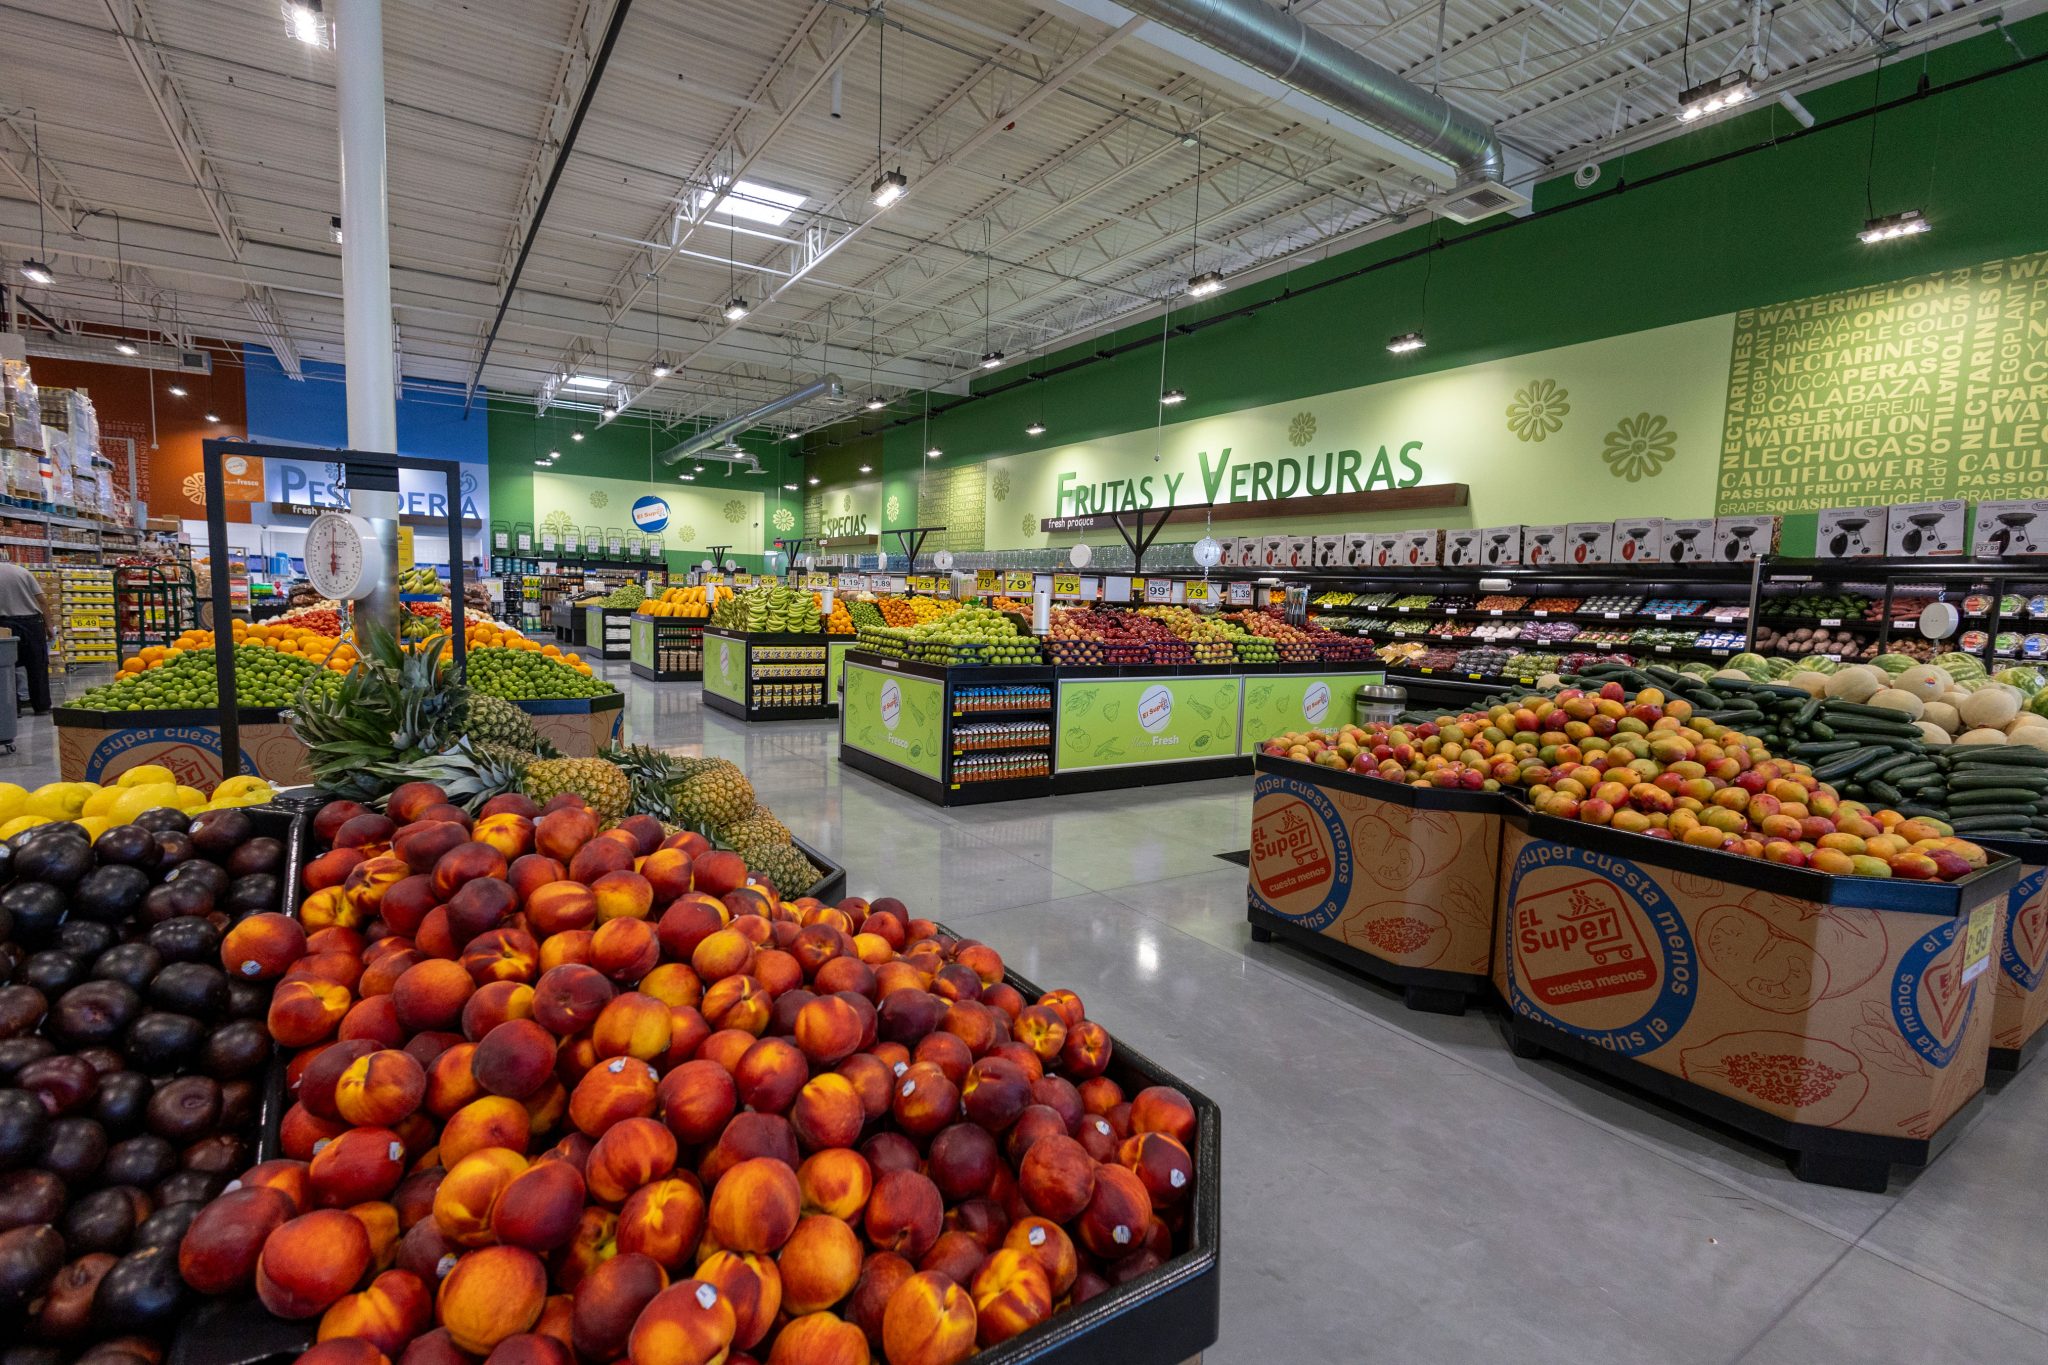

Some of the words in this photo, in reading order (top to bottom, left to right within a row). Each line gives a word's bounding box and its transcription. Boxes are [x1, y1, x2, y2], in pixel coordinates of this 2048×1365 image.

[1758, 278, 1945, 327] WATERMELON
[1775, 315, 1850, 342] PAPAYA
[1853, 294, 1971, 328] ONIONS
[1773, 325, 1892, 357] PINEAPPLE
[1898, 313, 1969, 336] GOLD
[1998, 283, 2028, 385] EGGPLANT
[1751, 329, 1772, 415] EGGPLANT
[1771, 335, 1940, 376] NECTARINES
[1959, 288, 2001, 450] NECTARINES
[1770, 370, 1840, 394] YUCCA
[1842, 357, 1938, 385] PERAS
[1930, 330, 1964, 454] TOMATILLO
[1722, 333, 1753, 470] NECTARINES
[1768, 376, 1931, 413] CALABAZA
[1745, 406, 1849, 431] PARSLEY
[1850, 397, 1931, 419] PEREJIL
[1745, 412, 1929, 449] WATERMELON
[1743, 434, 1927, 469] LECHUGAS
[1056, 471, 1153, 518] FRUTAS
[1164, 472, 1184, 507] Y
[1198, 440, 1424, 504] VERDURAS
[1721, 458, 1925, 488] CAULIFLOWER
[1721, 487, 1796, 501] PASSION
[1804, 482, 1862, 496] FRUIT
[1866, 477, 1923, 492] PEAR
[1957, 470, 2048, 487] PASSIO
[281, 465, 480, 520] PESERA
[292, 505, 318, 515] fresh
[1718, 501, 1765, 514] GRAPE
[1765, 498, 1833, 512] SQUASH
[1835, 493, 1921, 508] LETTUCE
[1954, 487, 2018, 501] GRAPE
[819, 509, 867, 539] ESPECIAS
[1048, 516, 1066, 529] fresh
[1067, 517, 1094, 530] produce
[102, 727, 157, 755] super
[1152, 735, 1179, 746] Fresh
[1252, 826, 1267, 844] EL
[1254, 828, 1307, 862] Super
[1289, 779, 1334, 820] cuesta
[1331, 821, 1349, 885] menos
[1269, 878, 1297, 893] cuesta
[1298, 866, 1326, 883] menos
[1519, 908, 1543, 930] EL
[1520, 845, 1575, 868] super
[1582, 850, 1660, 907] cuesta
[1656, 911, 1690, 996] menos
[1520, 915, 1612, 954] Super
[1922, 934, 1941, 952] el
[1547, 977, 1595, 997] cuesta
[1596, 969, 1647, 988] menos
[1898, 972, 1921, 1034] menos
[1645, 1016, 1668, 1043] el
